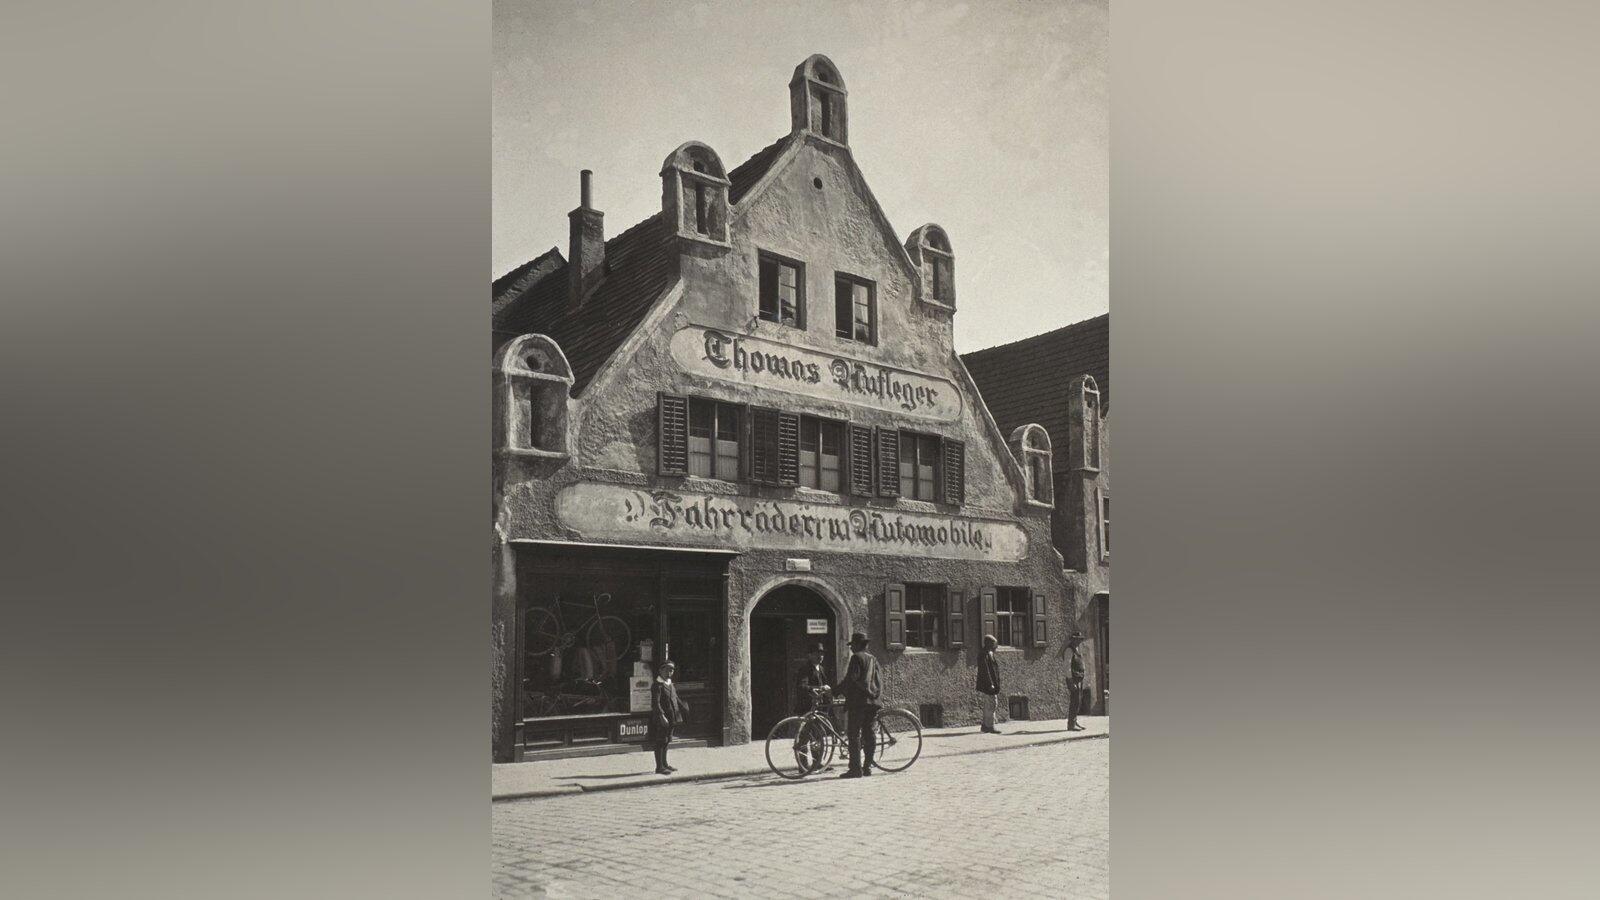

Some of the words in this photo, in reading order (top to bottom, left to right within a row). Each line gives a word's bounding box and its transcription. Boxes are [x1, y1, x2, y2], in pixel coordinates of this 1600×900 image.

[702, 329, 821, 384] Thomas
[828, 358, 939, 411] Aufleger
[620, 724, 648, 736] Dunlop
